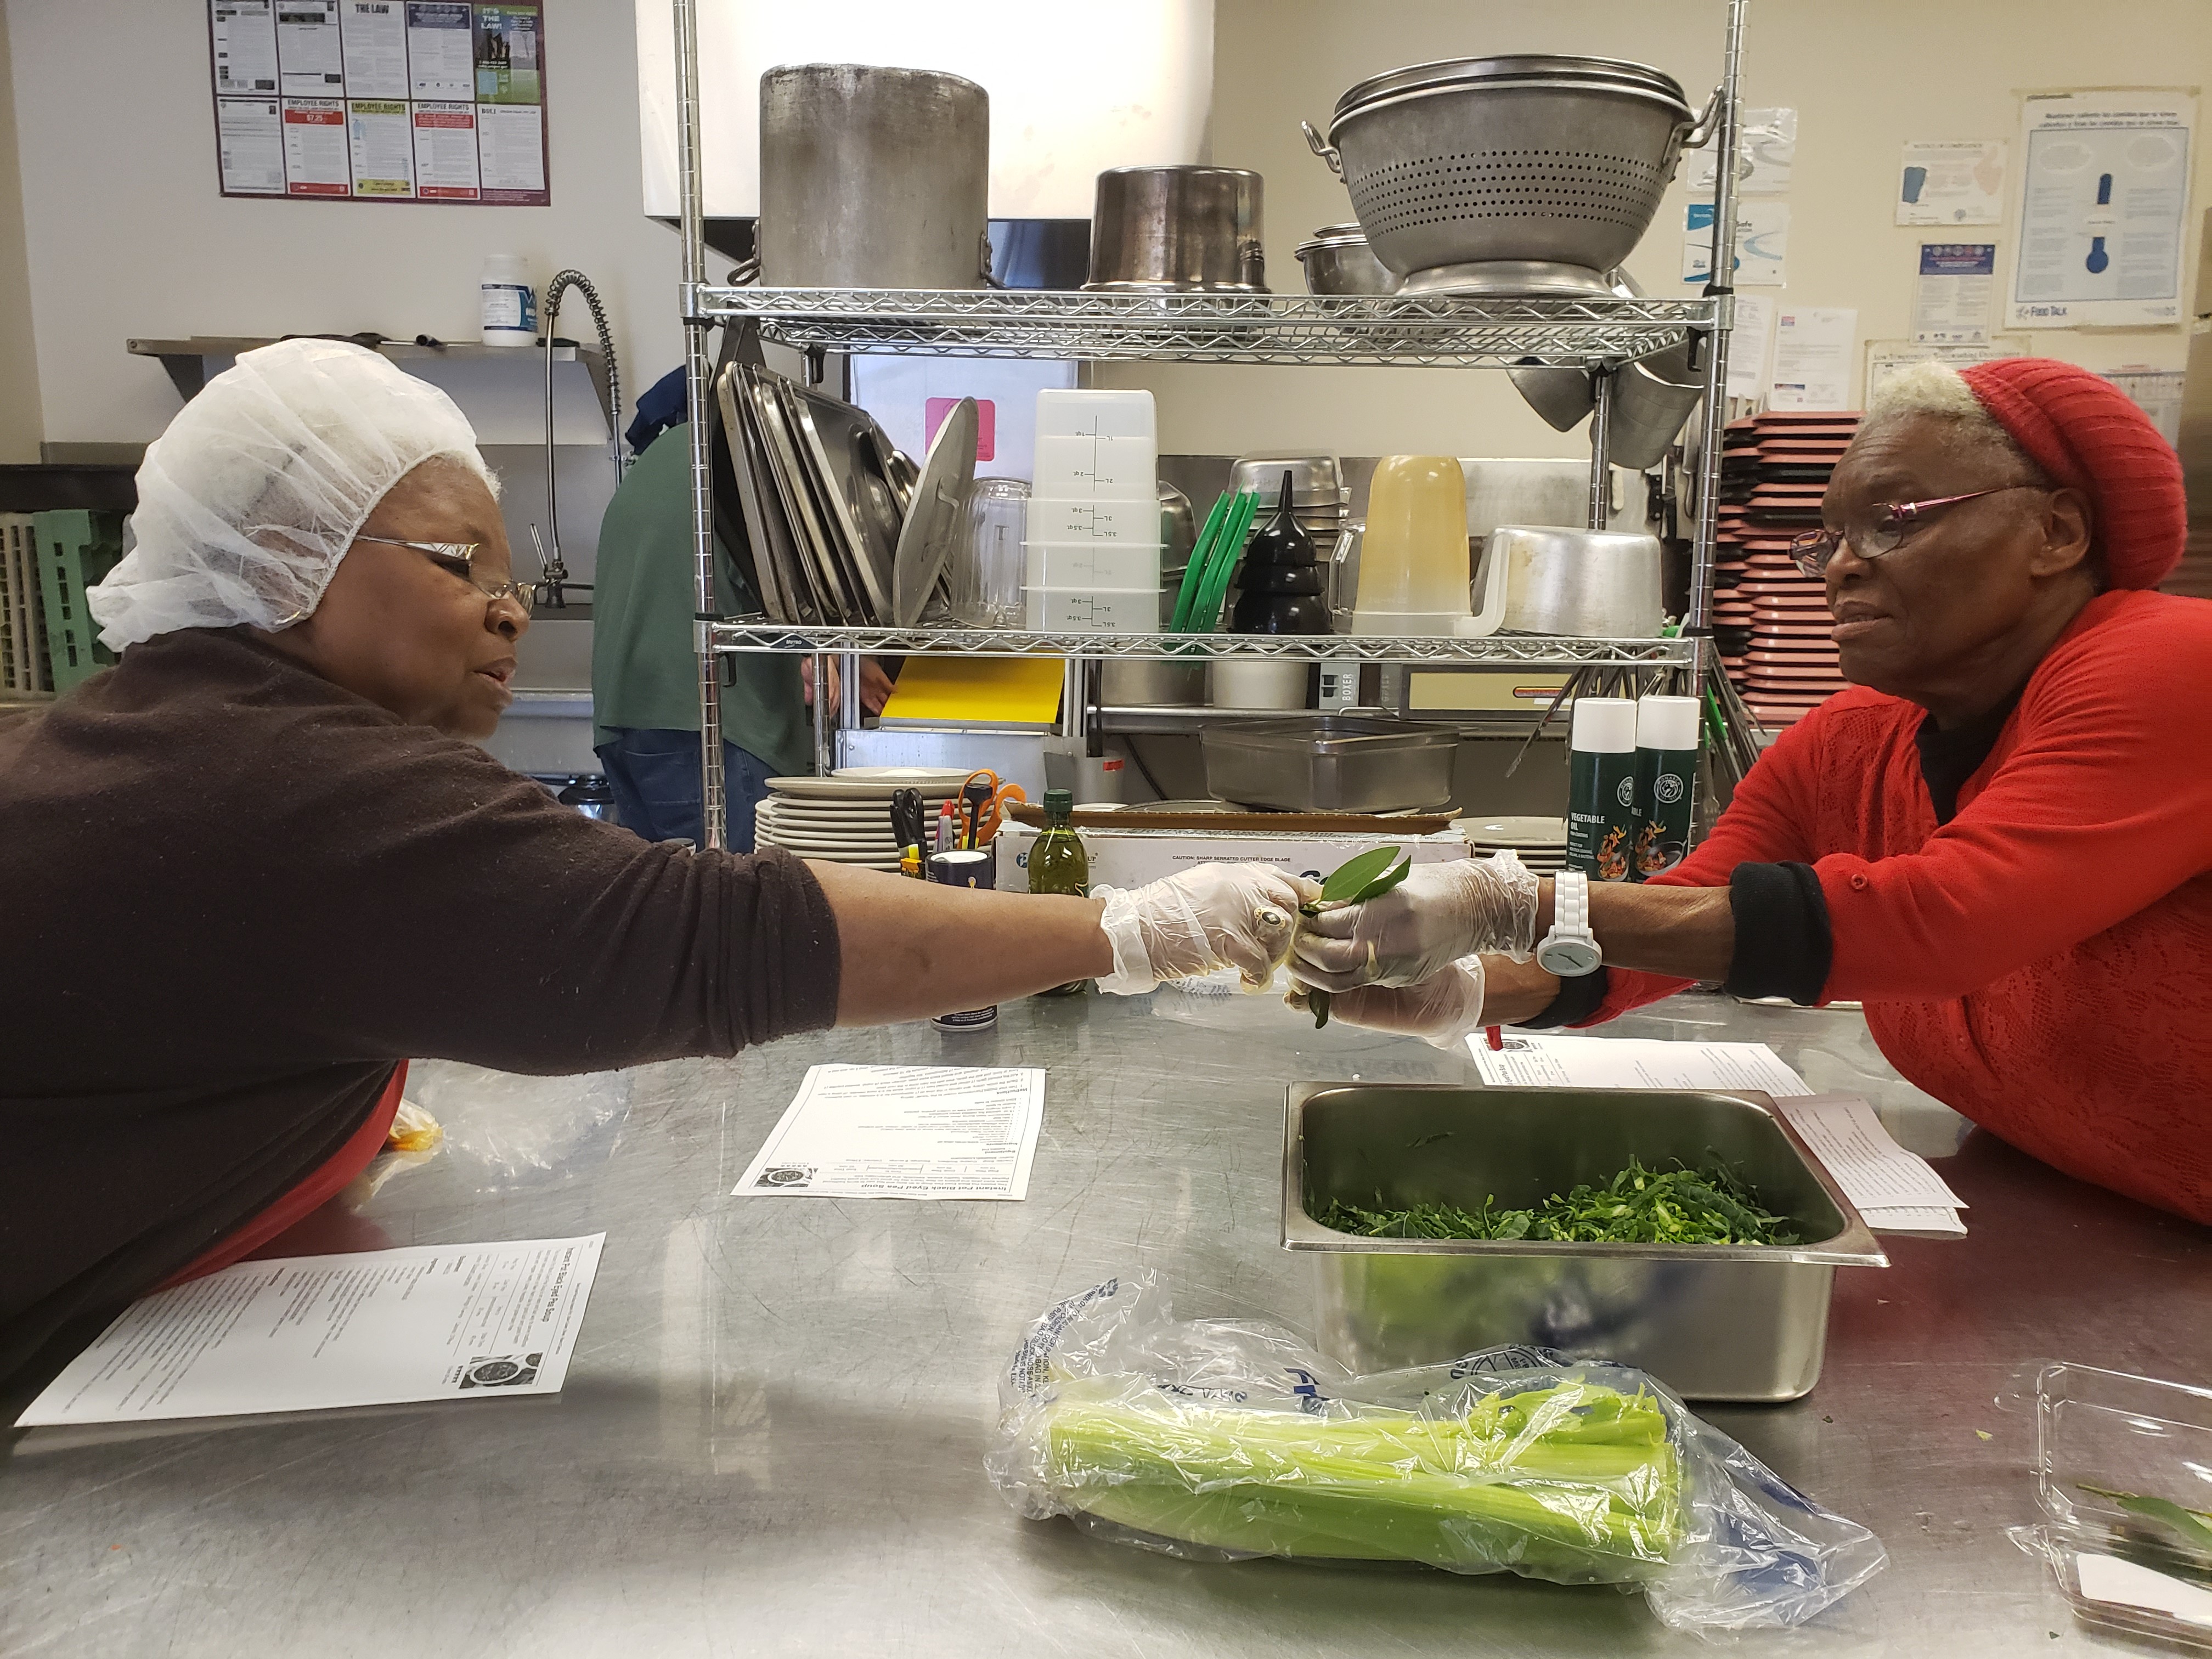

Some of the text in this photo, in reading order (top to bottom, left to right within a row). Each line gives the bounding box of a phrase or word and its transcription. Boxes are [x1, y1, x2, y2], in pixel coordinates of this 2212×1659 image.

[1342, 673, 1351, 701] BOXER
[1658, 775, 1681, 787] MONARCH
[1571, 812, 1605, 823] VEGETABLE
[1570, 822, 1578, 830] OIL
